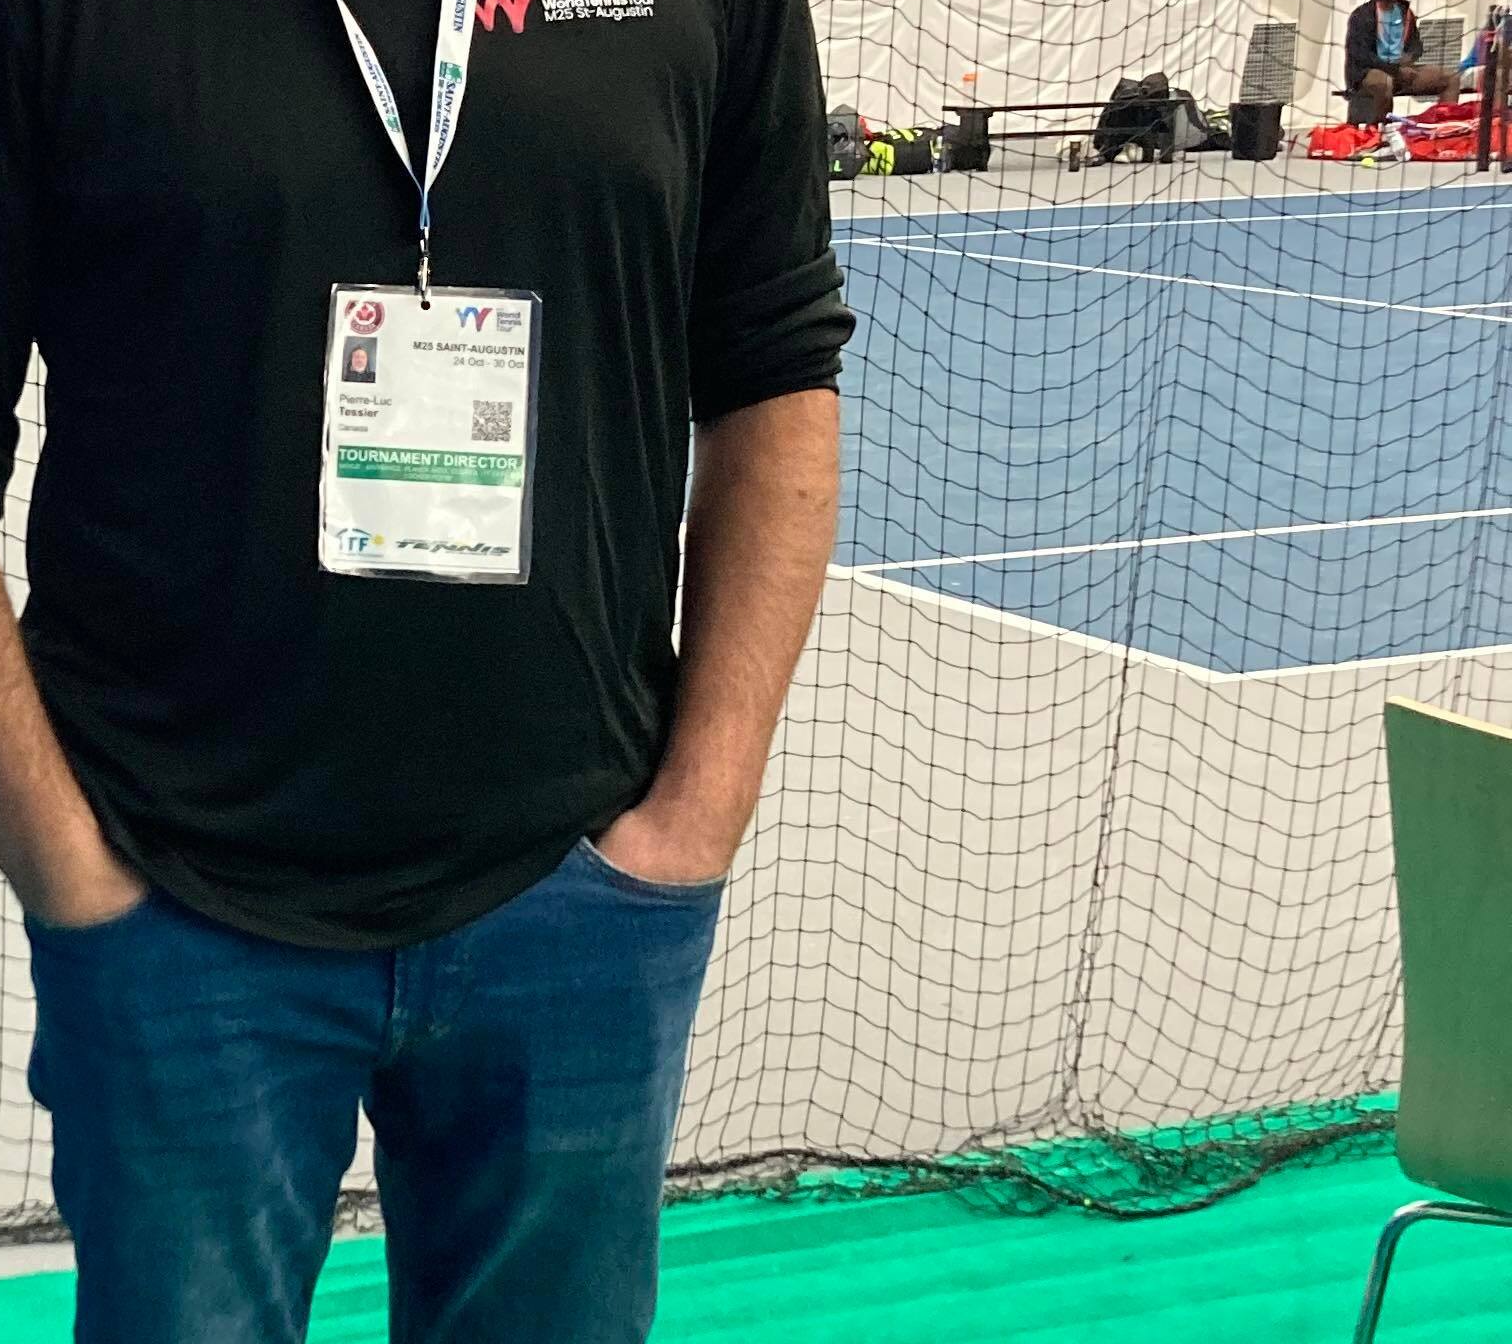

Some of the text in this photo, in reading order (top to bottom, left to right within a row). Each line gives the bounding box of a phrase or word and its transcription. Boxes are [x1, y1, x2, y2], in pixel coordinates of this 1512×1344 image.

[544, 6, 654, 22] M25 St-Augustin
[434, 81, 456, 169] SAINT-AUGUSTIN
[413, 341, 525, 355] M25 SAINT-AUGUSTIN
[453, 357, 465, 366] 24
[468, 357, 484, 367] Oct
[494, 359, 505, 368] 30
[508, 359, 525, 369] Oct
[339, 449, 517, 469] TOURNAMENT DIRECTOR
